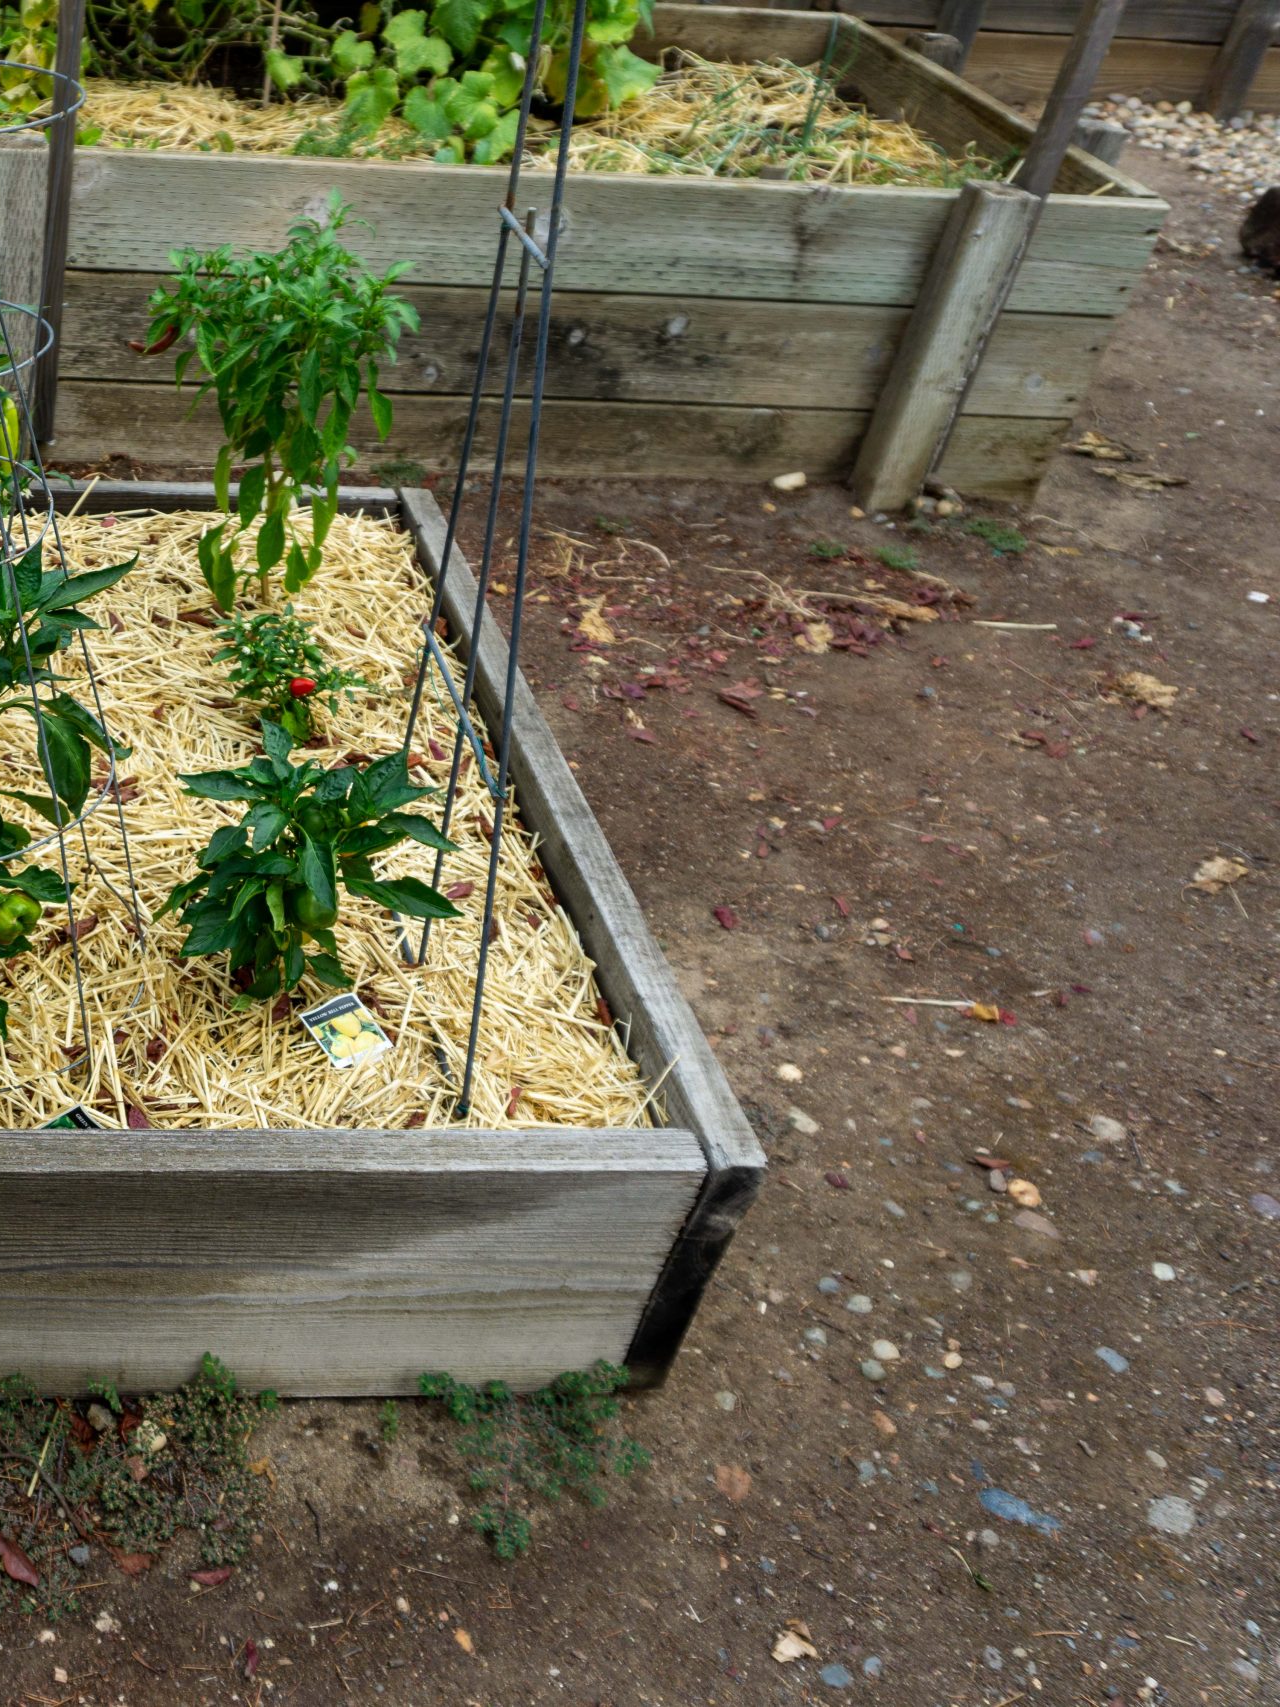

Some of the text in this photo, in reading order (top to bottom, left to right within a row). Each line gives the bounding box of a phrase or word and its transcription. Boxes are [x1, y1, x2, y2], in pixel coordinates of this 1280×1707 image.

[309, 1001, 355, 1022] YELLOW BELL PEPPER
